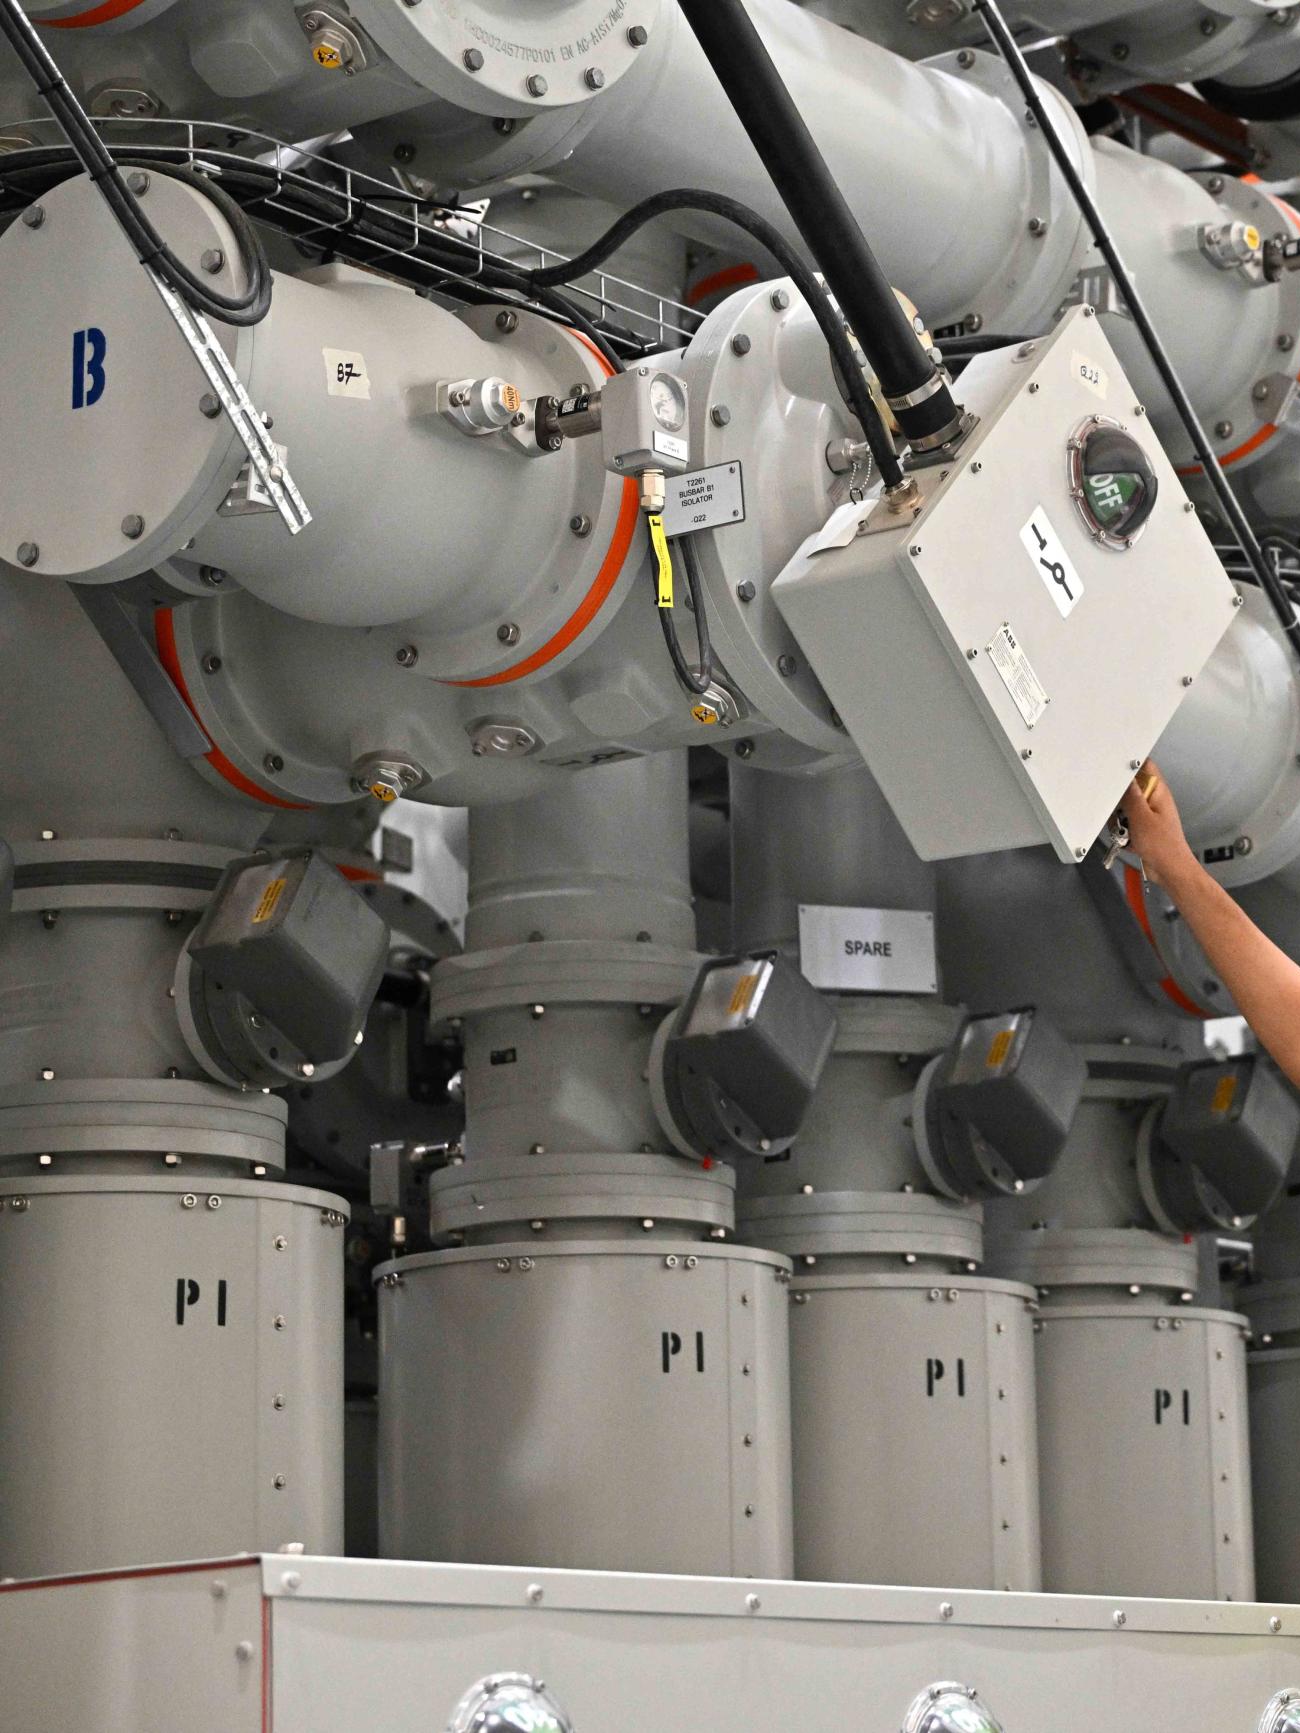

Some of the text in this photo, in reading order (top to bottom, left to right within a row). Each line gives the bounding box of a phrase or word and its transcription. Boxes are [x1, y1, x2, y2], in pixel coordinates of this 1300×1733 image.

[72, 328, 106, 410] B
[506, 385, 516, 410] 40Nm
[679, 486, 705, 499] BUSBAR
[681, 494, 713, 507] ISOLATOR
[1089, 473, 1124, 509] OFF
[1003, 628, 1017, 650] ABB
[844, 939, 893, 957] SPARE
